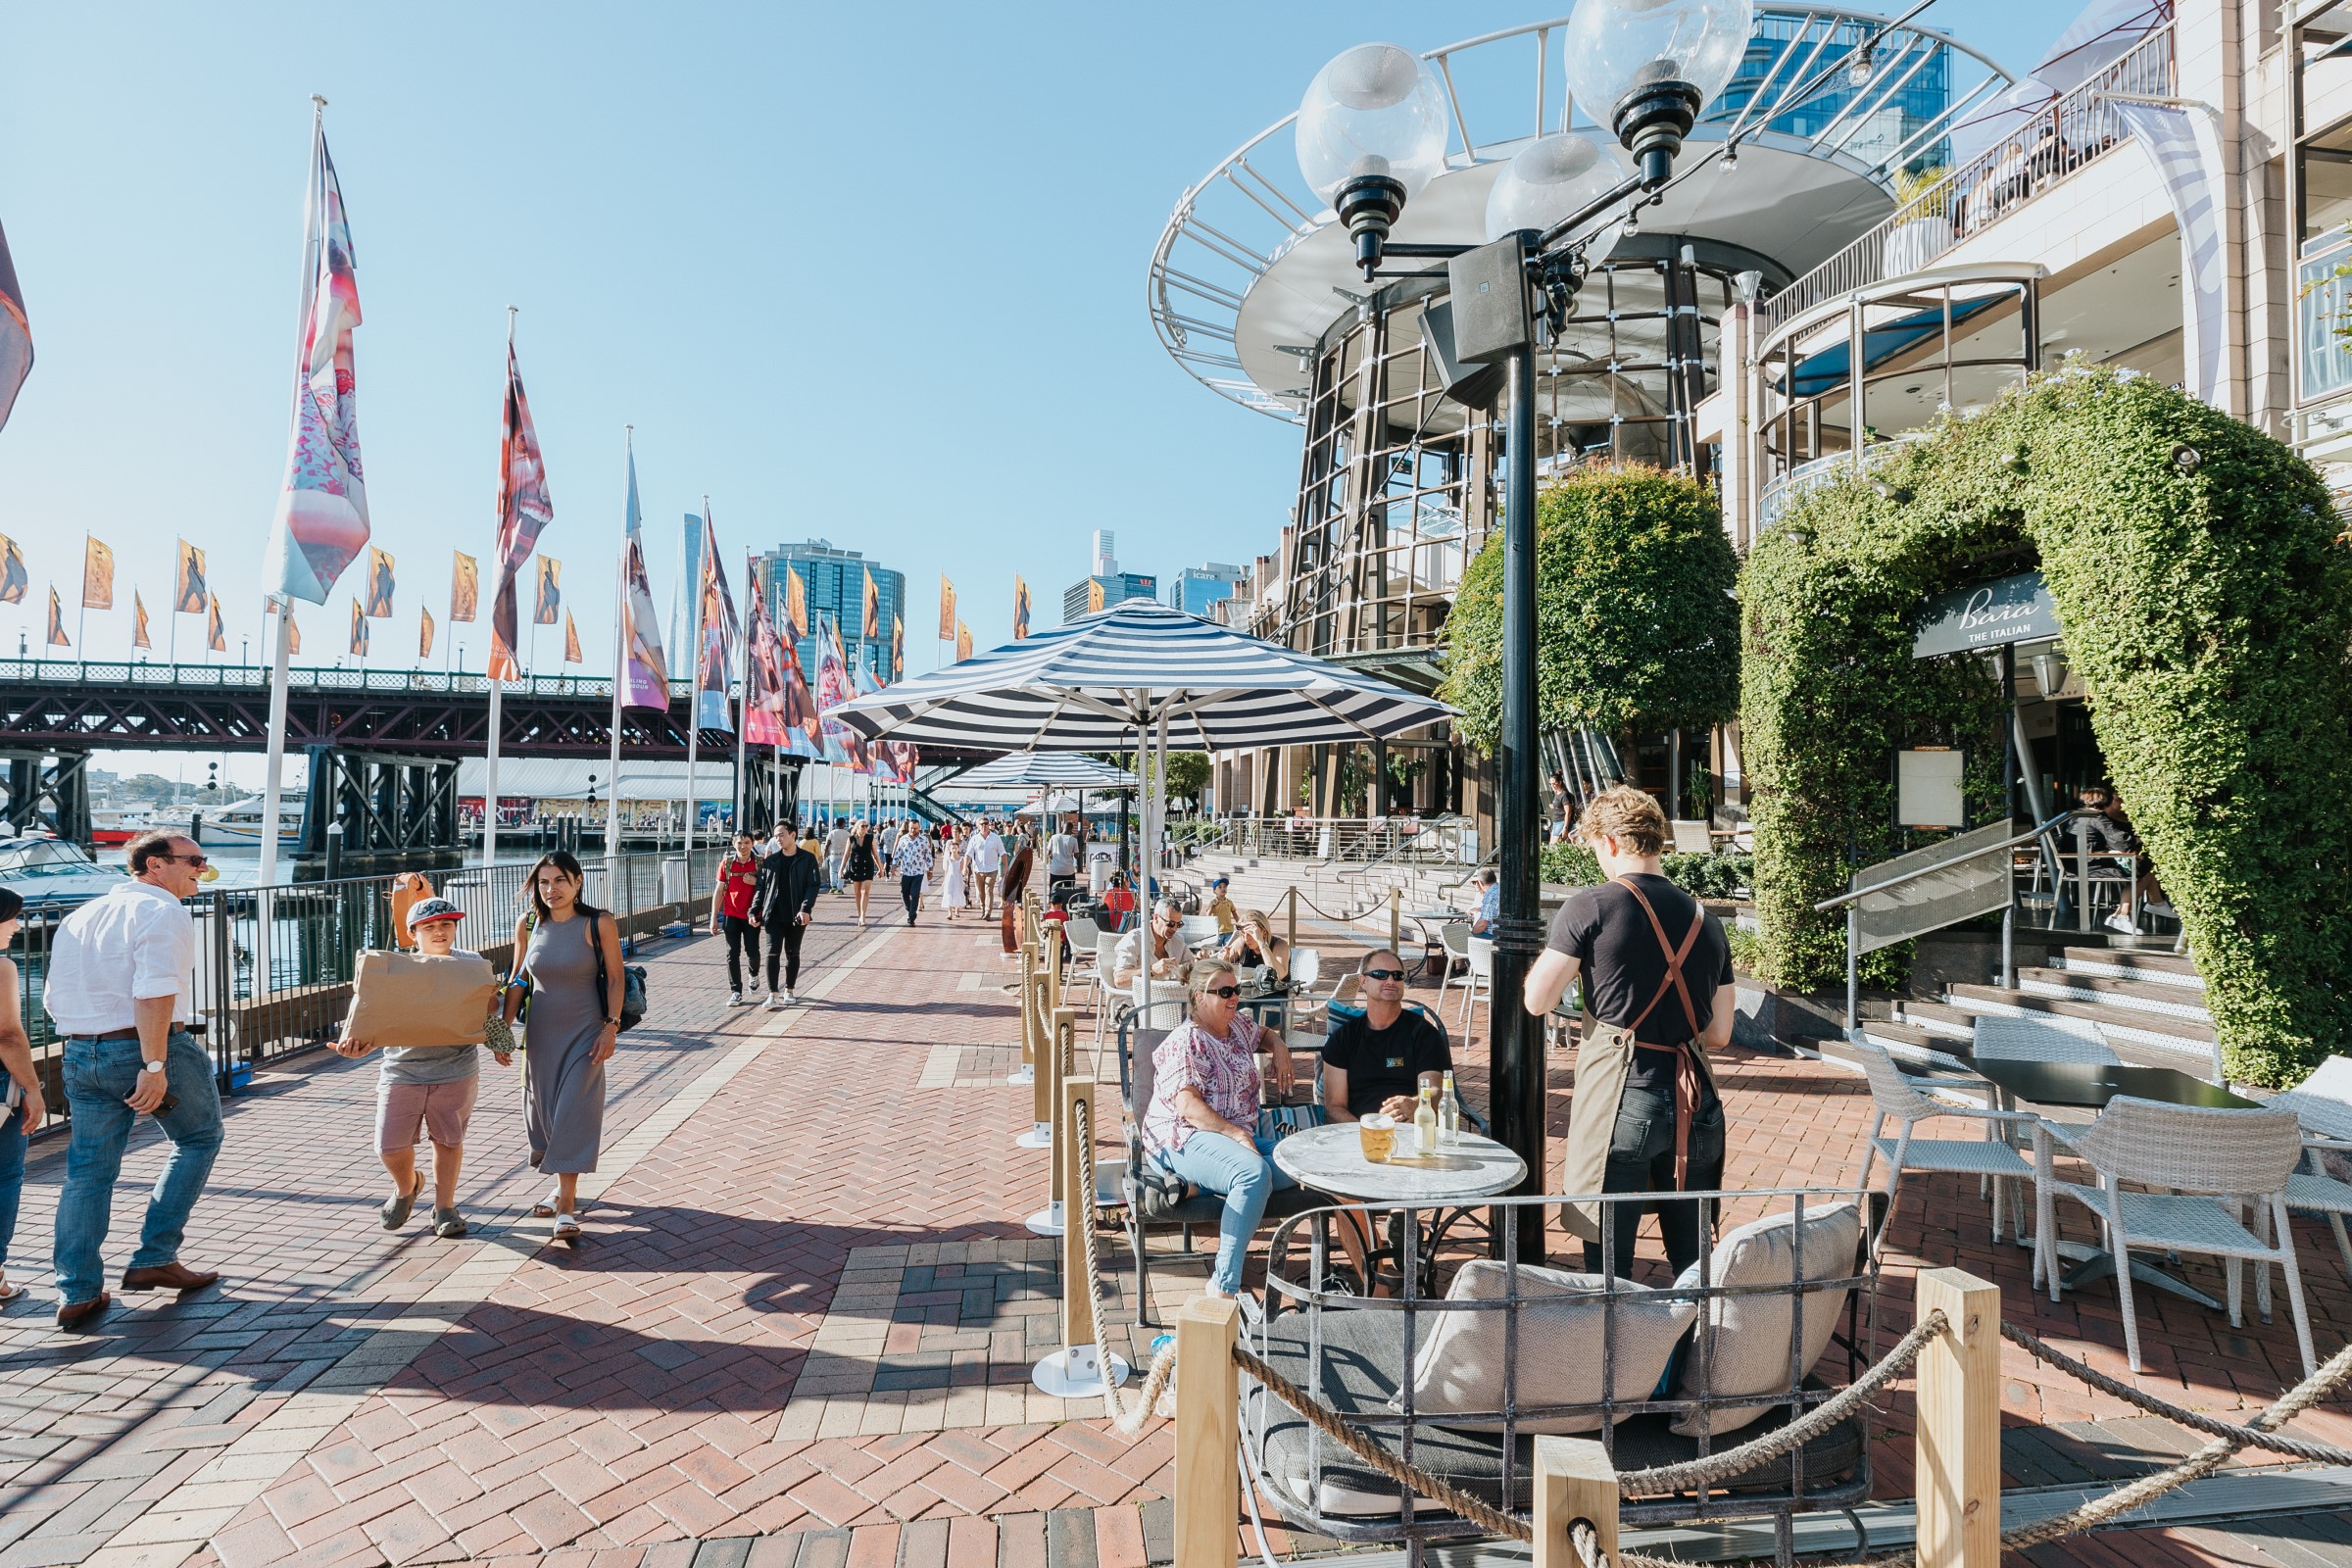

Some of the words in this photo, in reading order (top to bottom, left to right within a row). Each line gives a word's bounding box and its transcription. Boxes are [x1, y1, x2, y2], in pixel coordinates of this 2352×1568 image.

[1193, 570, 1215, 580] icare
[1959, 587, 2040, 630] Baia
[1968, 630, 1987, 643] THE
[1990, 623, 2032, 640] ITALIAN
